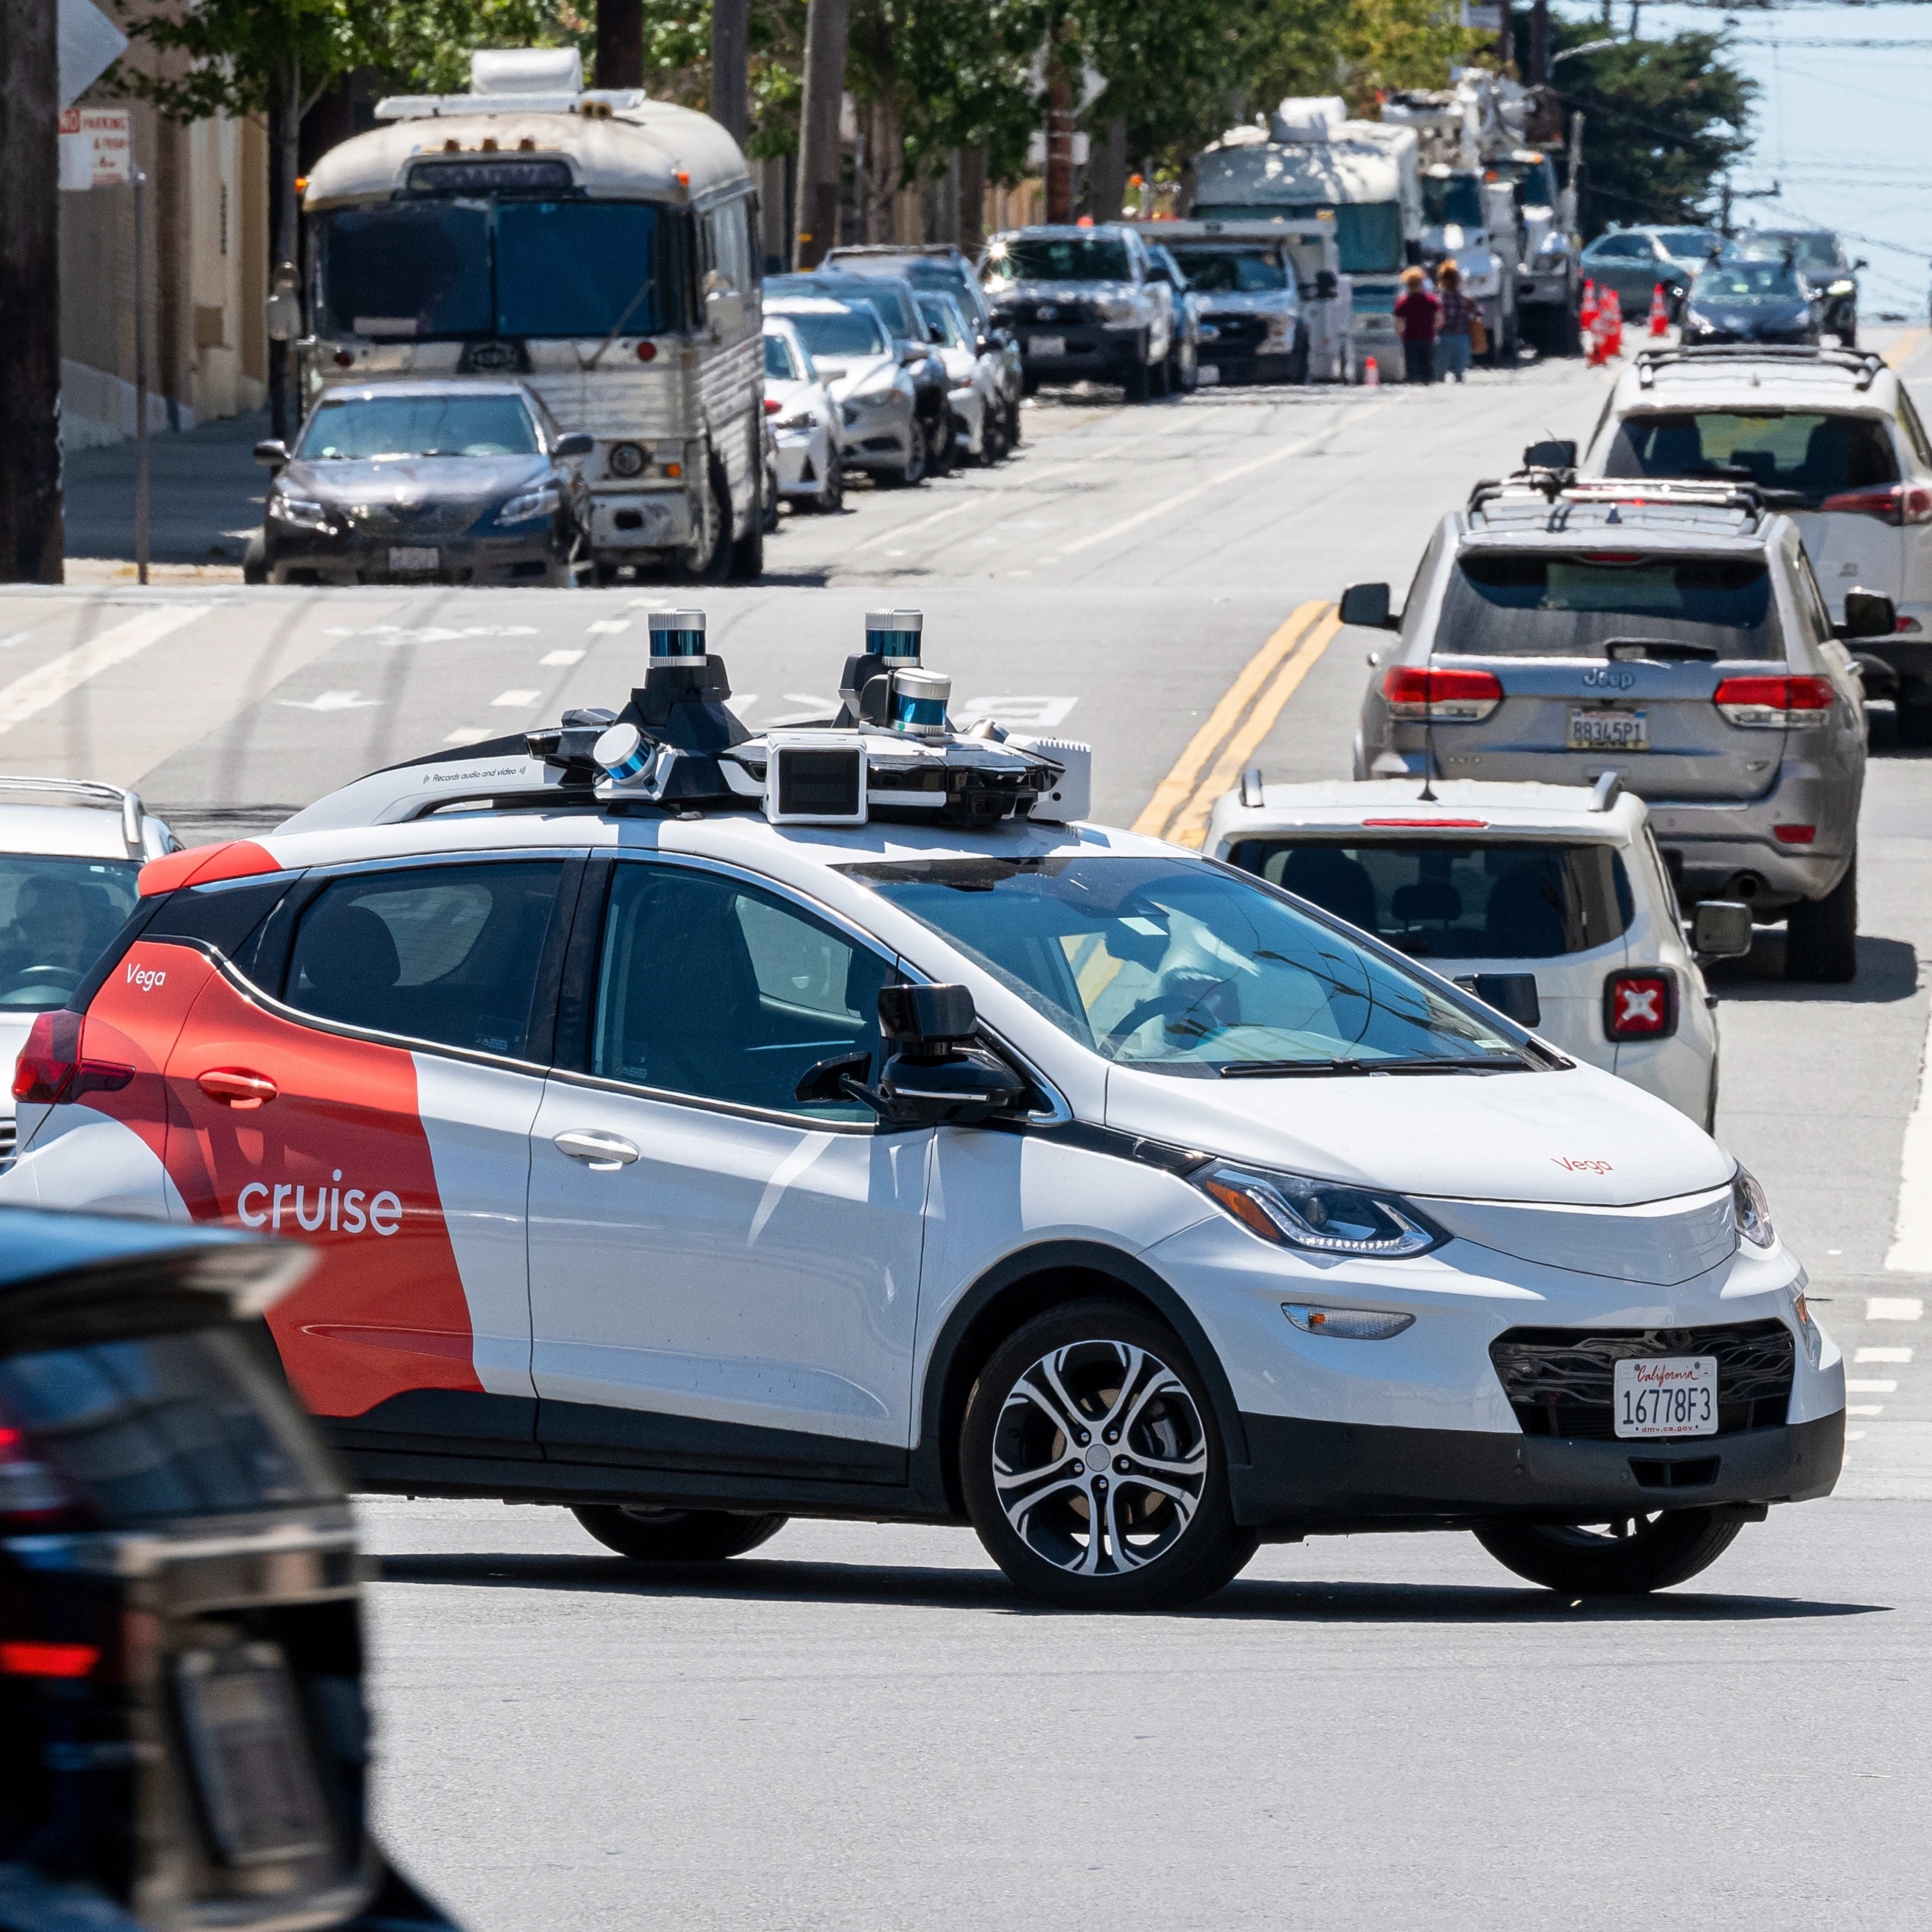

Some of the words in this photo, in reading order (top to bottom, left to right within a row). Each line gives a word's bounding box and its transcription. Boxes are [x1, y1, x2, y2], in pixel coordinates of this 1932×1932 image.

[1583, 668, 1634, 691] Jeep
[433, 773, 460, 782] Records
[461, 771, 480, 779] audio
[481, 769, 497, 777] and
[497, 767, 516, 776] video
[127, 963, 166, 992] Vega
[1550, 1157, 1614, 1174] Vega
[237, 1169, 402, 1236] cruise
[1638, 1364, 1699, 1388] California
[1623, 1387, 1711, 1424] 16778F3
